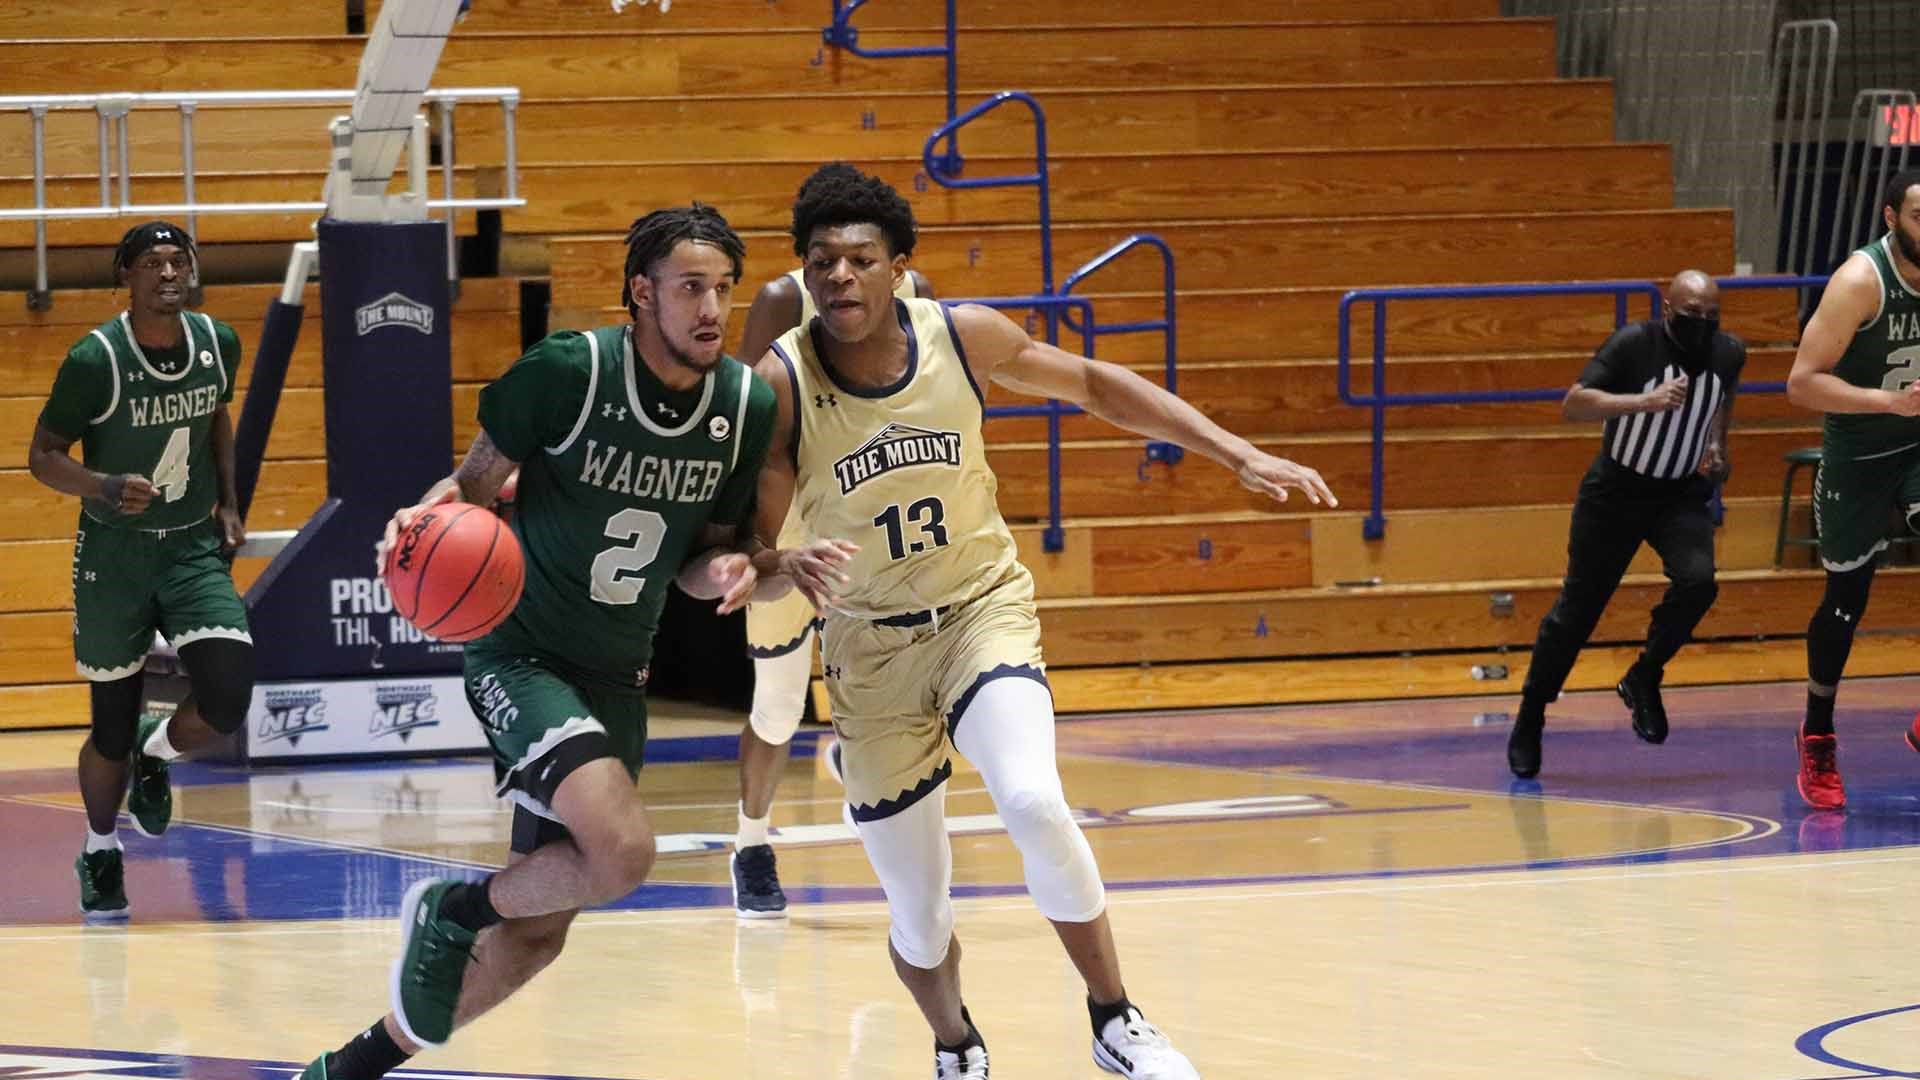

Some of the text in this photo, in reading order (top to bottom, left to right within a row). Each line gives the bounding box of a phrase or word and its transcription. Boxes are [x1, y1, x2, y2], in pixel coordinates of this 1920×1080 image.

[809, 48, 822, 66] J
[861, 111, 877, 130] H
[969, 247, 981, 268] F
[360, 304, 430, 328] THE MOUNT
[129, 384, 217, 427] WAGNER
[153, 426, 190, 503] 4
[580, 439, 724, 503] WAGNER
[837, 434, 959, 491] THE MOUNT
[398, 513, 437, 572] NCAA
[873, 496, 950, 561] 13
[590, 507, 668, 605] 2
[331, 617, 381, 647] THI
[1255, 614, 1268, 637] A
[258, 700, 328, 738] NEC
[369, 696, 439, 733] NEC
